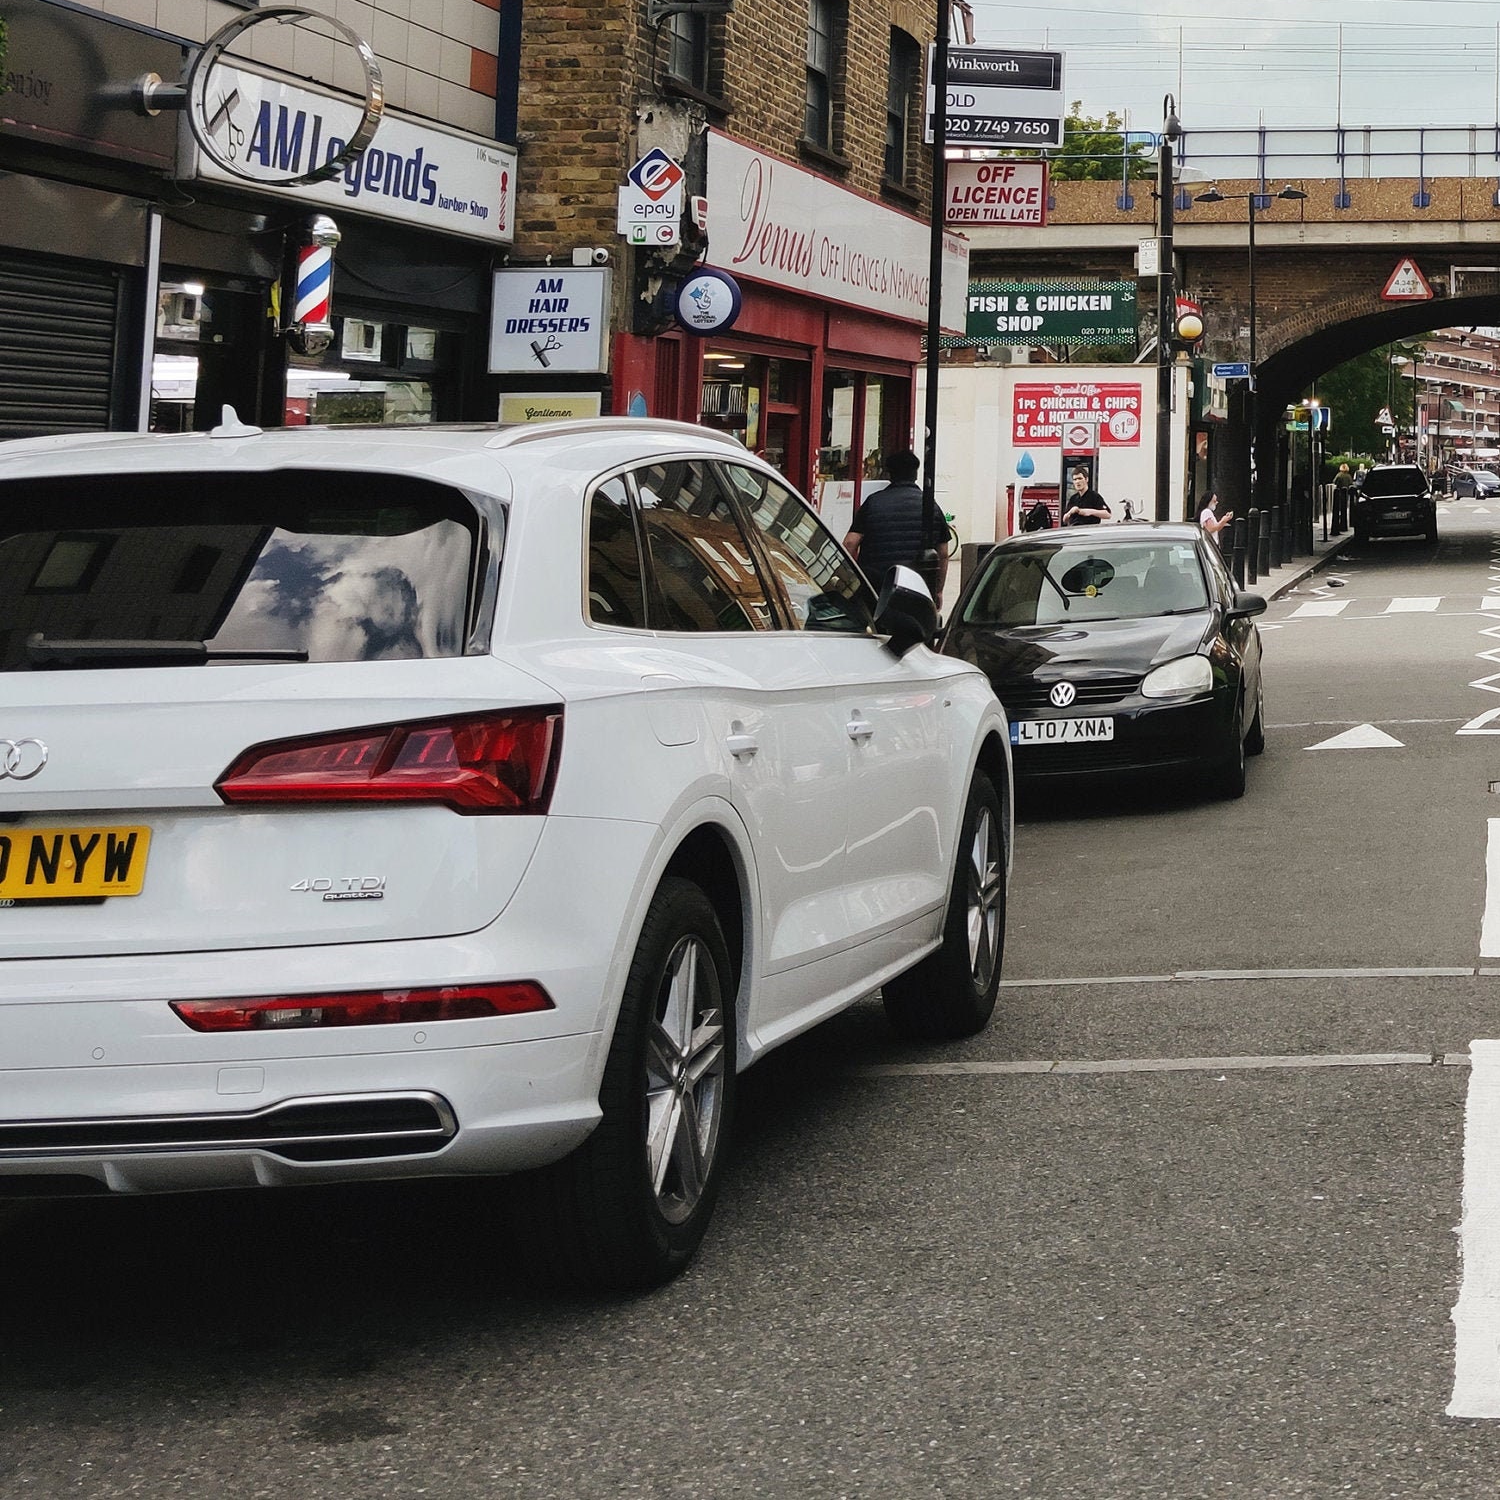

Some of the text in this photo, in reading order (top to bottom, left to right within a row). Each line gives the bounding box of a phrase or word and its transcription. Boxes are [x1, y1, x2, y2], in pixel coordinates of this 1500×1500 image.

[946, 56, 1019, 72] Winkworth
[945, 93, 975, 108] OLD
[974, 120, 1010, 133] 7749
[1014, 121, 1049, 135] 7650
[246, 99, 307, 174] AM
[977, 166, 1015, 183] OFF
[952, 186, 1039, 204] LICENCE
[438, 192, 488, 220] barber Shop
[633, 204, 675, 218] epay
[948, 207, 1040, 220] OPEN TILL LATE
[732, 158, 929, 307] Venus OFF LICENCE & NEWSAGE
[535, 278, 563, 293] AM
[528, 298, 569, 313] HAIR
[969, 295, 1112, 312] FISH & CHICKEN
[505, 317, 590, 334] DRESSERS
[996, 315, 1044, 332] SHOP
[1018, 397, 1138, 409] 1PC CHICKEN & CHIPS
[525, 407, 572, 420] Gentlemen
[1017, 411, 1110, 424] or 4 HOT WINGS
[1016, 425, 1062, 438] & CHIPS
[1073, 718, 1108, 738] XNA
[25, 832, 138, 885] NYW
[290, 875, 387, 892] 40 TDI
[324, 891, 382, 900] quattro
